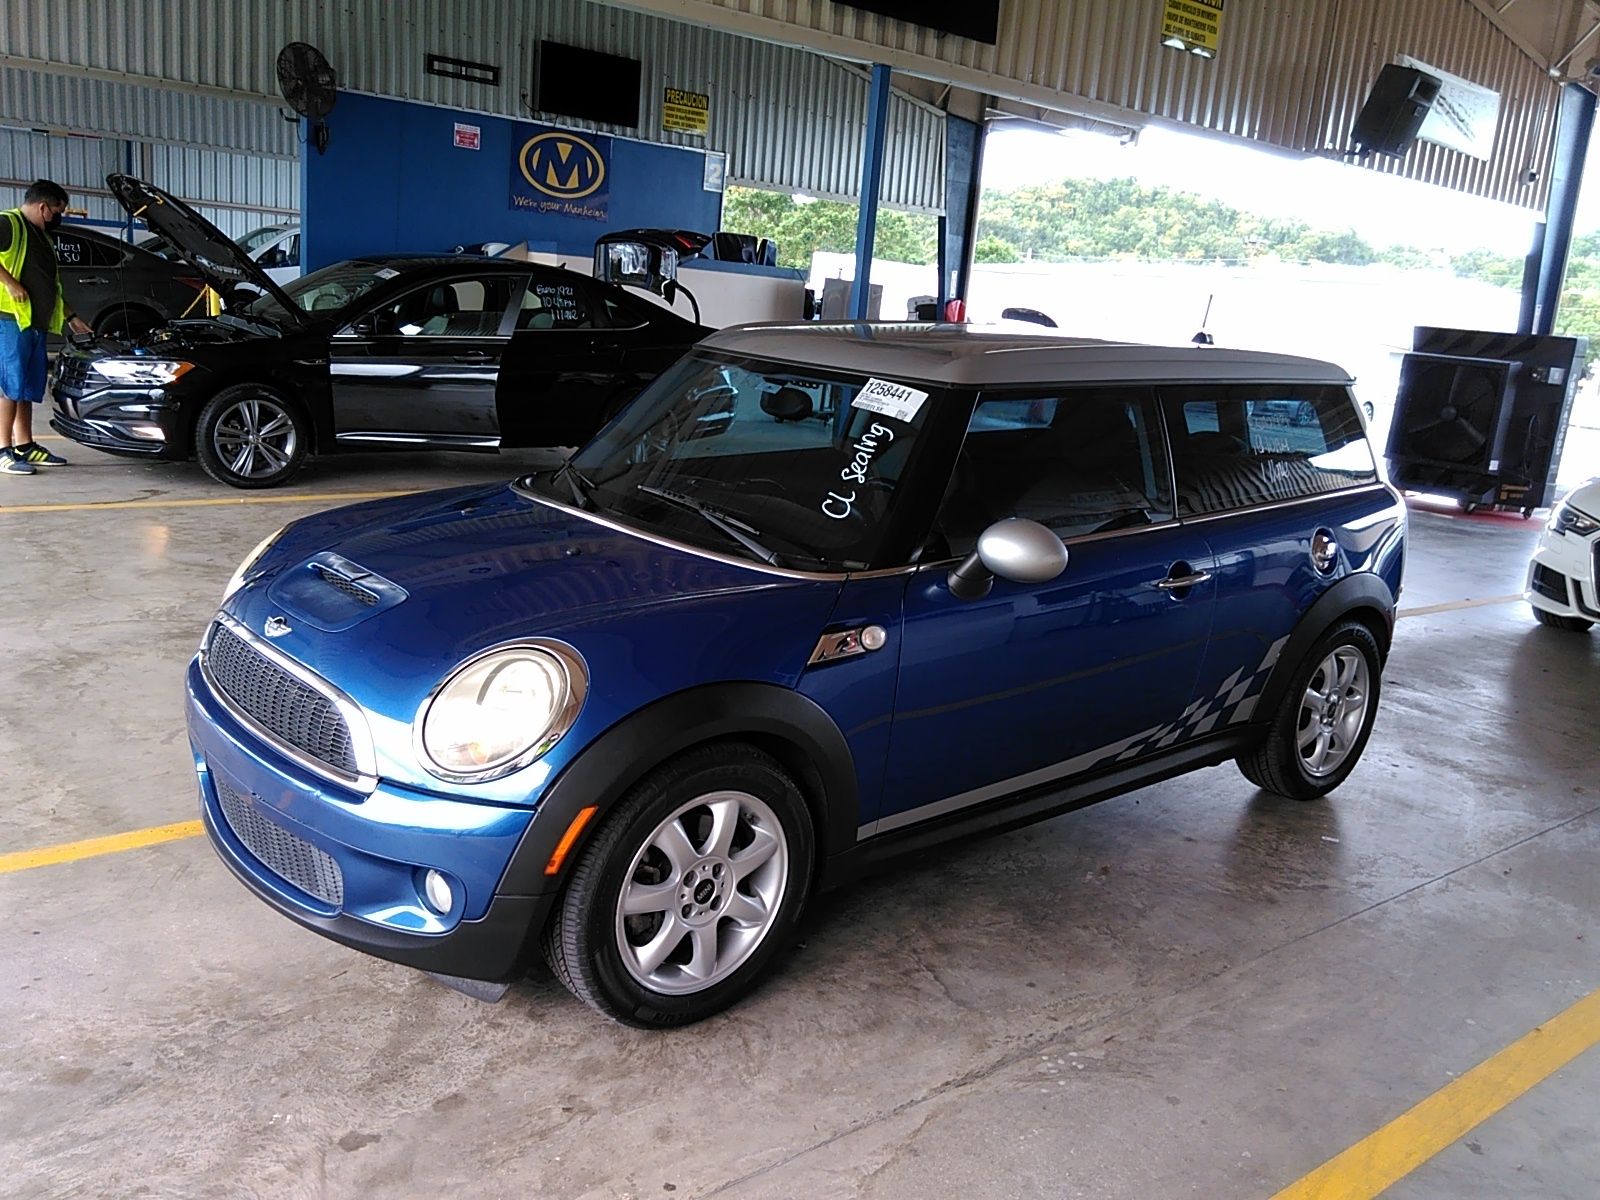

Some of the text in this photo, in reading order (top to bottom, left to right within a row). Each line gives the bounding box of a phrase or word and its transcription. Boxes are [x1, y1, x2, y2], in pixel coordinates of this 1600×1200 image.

[708, 163, 722, 184] 2
[538, 200, 561, 213] your
[865, 381, 913, 402] 1258441
[696, 883, 712, 901] MINI
